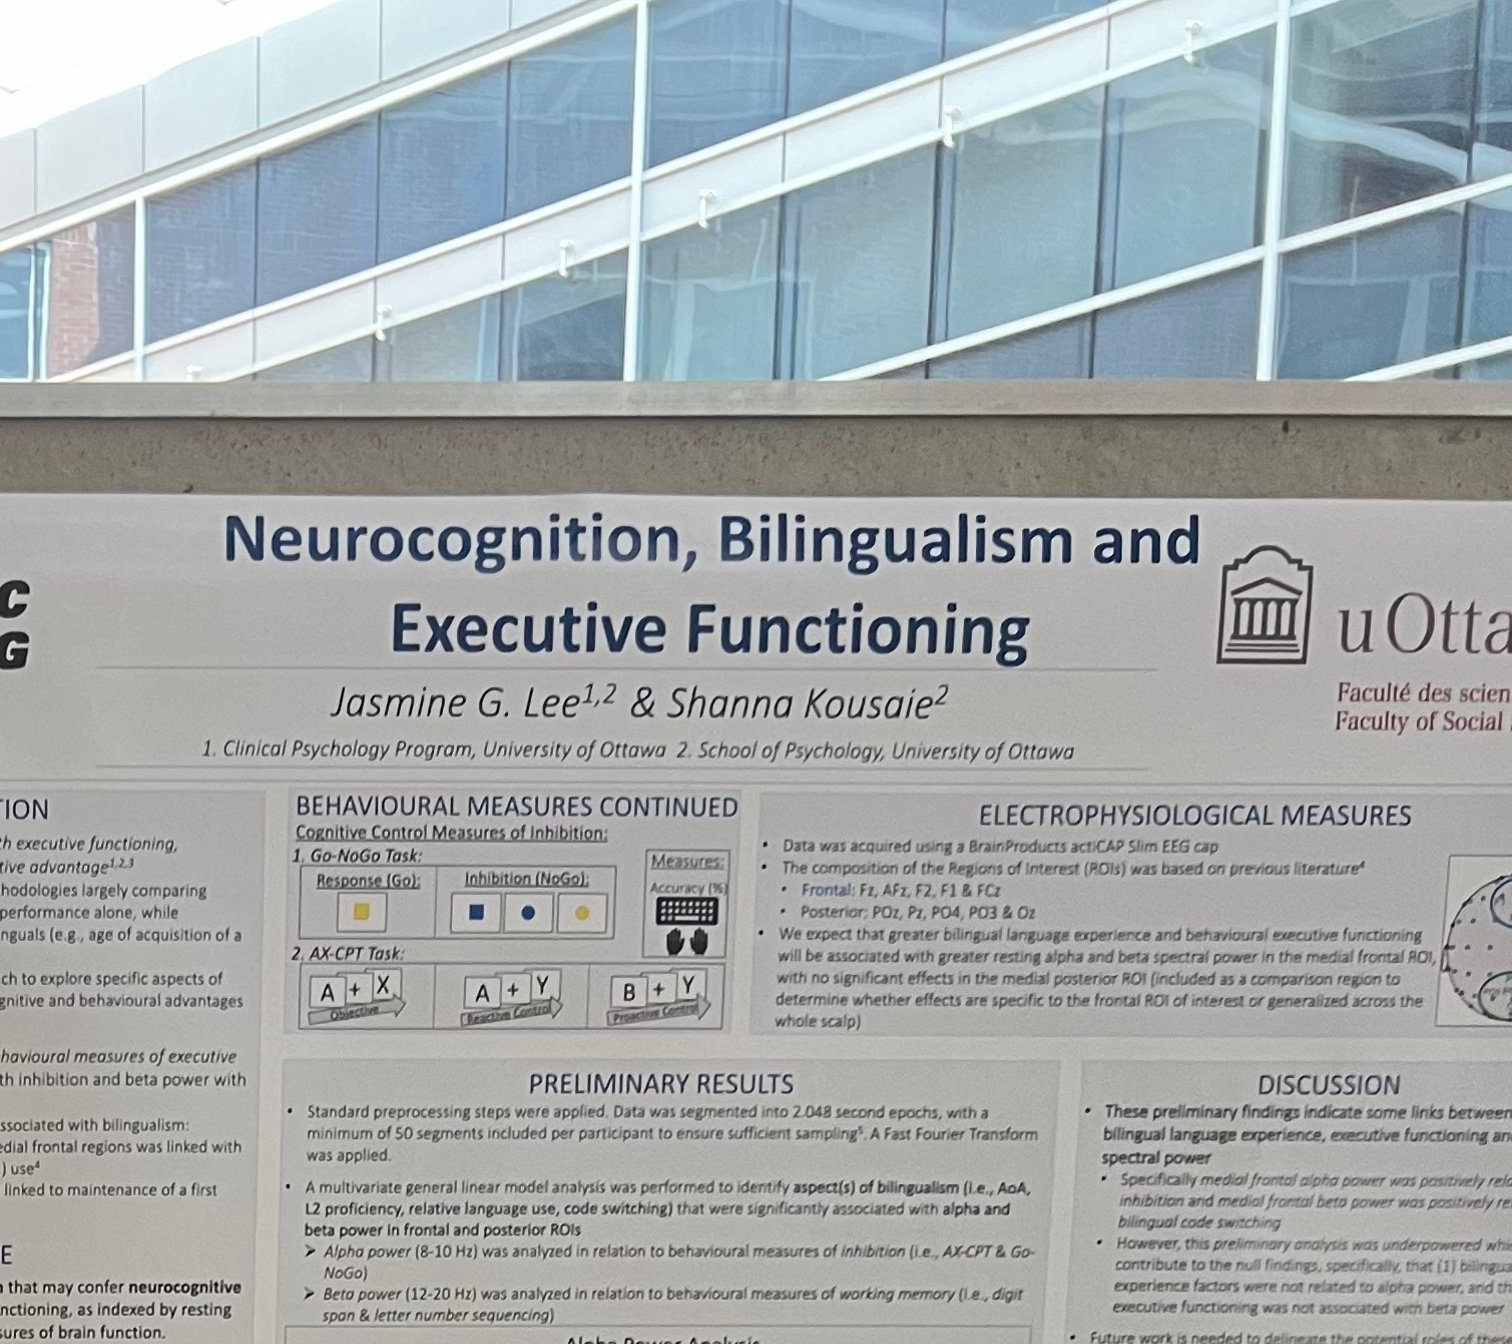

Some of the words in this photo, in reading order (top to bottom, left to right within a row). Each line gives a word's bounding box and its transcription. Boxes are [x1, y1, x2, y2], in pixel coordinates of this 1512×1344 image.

[226, 512, 696, 574] Neurocognition,
[721, 513, 1072, 575] Bilingualism
[1094, 514, 1199, 564] and
[389, 601, 672, 653] Executive
[688, 602, 1031, 668] Functioning
[330, 686, 466, 717] Jasmine
[479, 687, 508, 717] G.
[525, 683, 616, 718] Lee1,2
[631, 686, 655, 718] &
[667, 685, 793, 718] Shanna
[804, 684, 948, 719] Kousaie2
[1338, 682, 1411, 702] Faculté
[1418, 682, 1452, 702] des
[1336, 711, 1410, 736] Faculty
[1416, 711, 1439, 731] of
[1442, 711, 1503, 731] Social
[202, 739, 216, 757] 1.
[224, 739, 287, 757] Clinical
[291, 739, 390, 761] Psychology
[395, 740, 476, 761] Program,
[484, 740, 572, 762] University
[577, 739, 597, 762] of
[600, 741, 666, 758] Ottawa
[676, 741, 691, 758] 2.
[698, 740, 758, 758] School
[761, 741, 782, 763] of
[784, 741, 885, 763] Psychology,
[892, 742, 981, 764] University
[985, 741, 1006, 764] of
[1008, 743, 1074, 760] Ottawa
[297, 795, 460, 816] BEHAVIOURAL
[468, 796, 592, 817] MEASURES
[600, 796, 738, 817] CONTINUED
[980, 804, 1274, 826] ELECTROPHYSIOLOGICAL
[1281, 804, 1411, 826] MEASURES
[16, 836, 85, 851] executive
[87, 835, 177, 854] functioning,
[530, 1073, 690, 1094] PRELIMINARY
[697, 1073, 793, 1094] RESULTS
[1258, 1074, 1400, 1095] DISCUSSION
[8, 1280, 37, 1294] that
[43, 1283, 73, 1297] may
[78, 1279, 124, 1294] confer
[129, 1280, 241, 1297] neurocognitive
